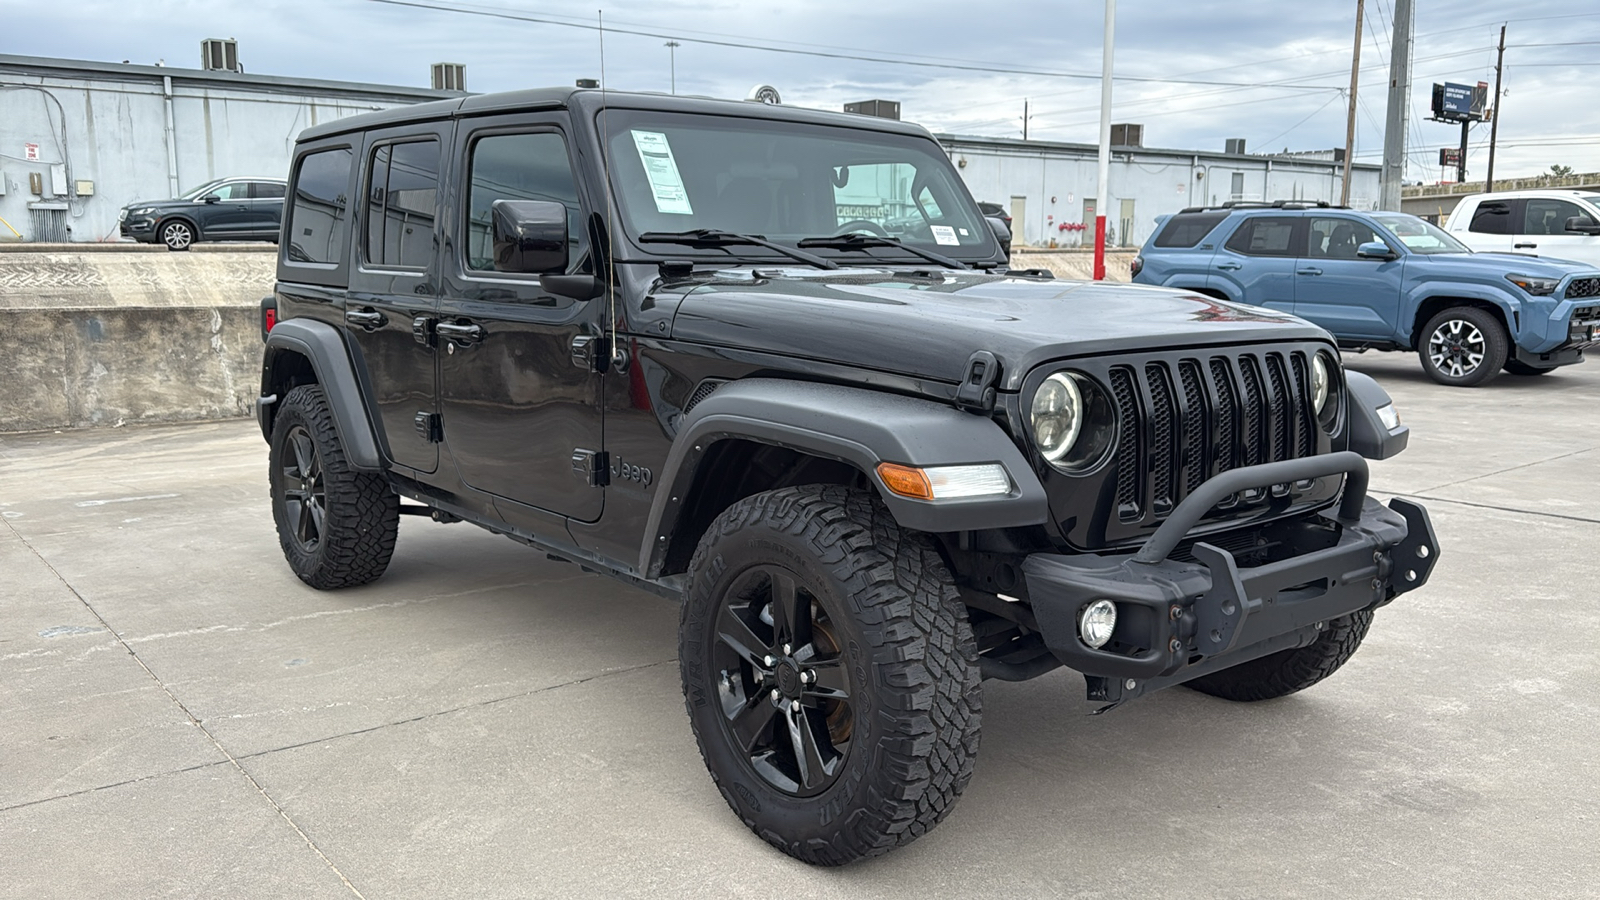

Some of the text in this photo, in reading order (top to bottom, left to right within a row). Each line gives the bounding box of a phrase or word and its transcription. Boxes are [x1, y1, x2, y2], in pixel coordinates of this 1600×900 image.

[610, 455, 652, 489] Jeep
[687, 552, 728, 708] WRANGLER
[818, 639, 873, 827] GOODYEAR
